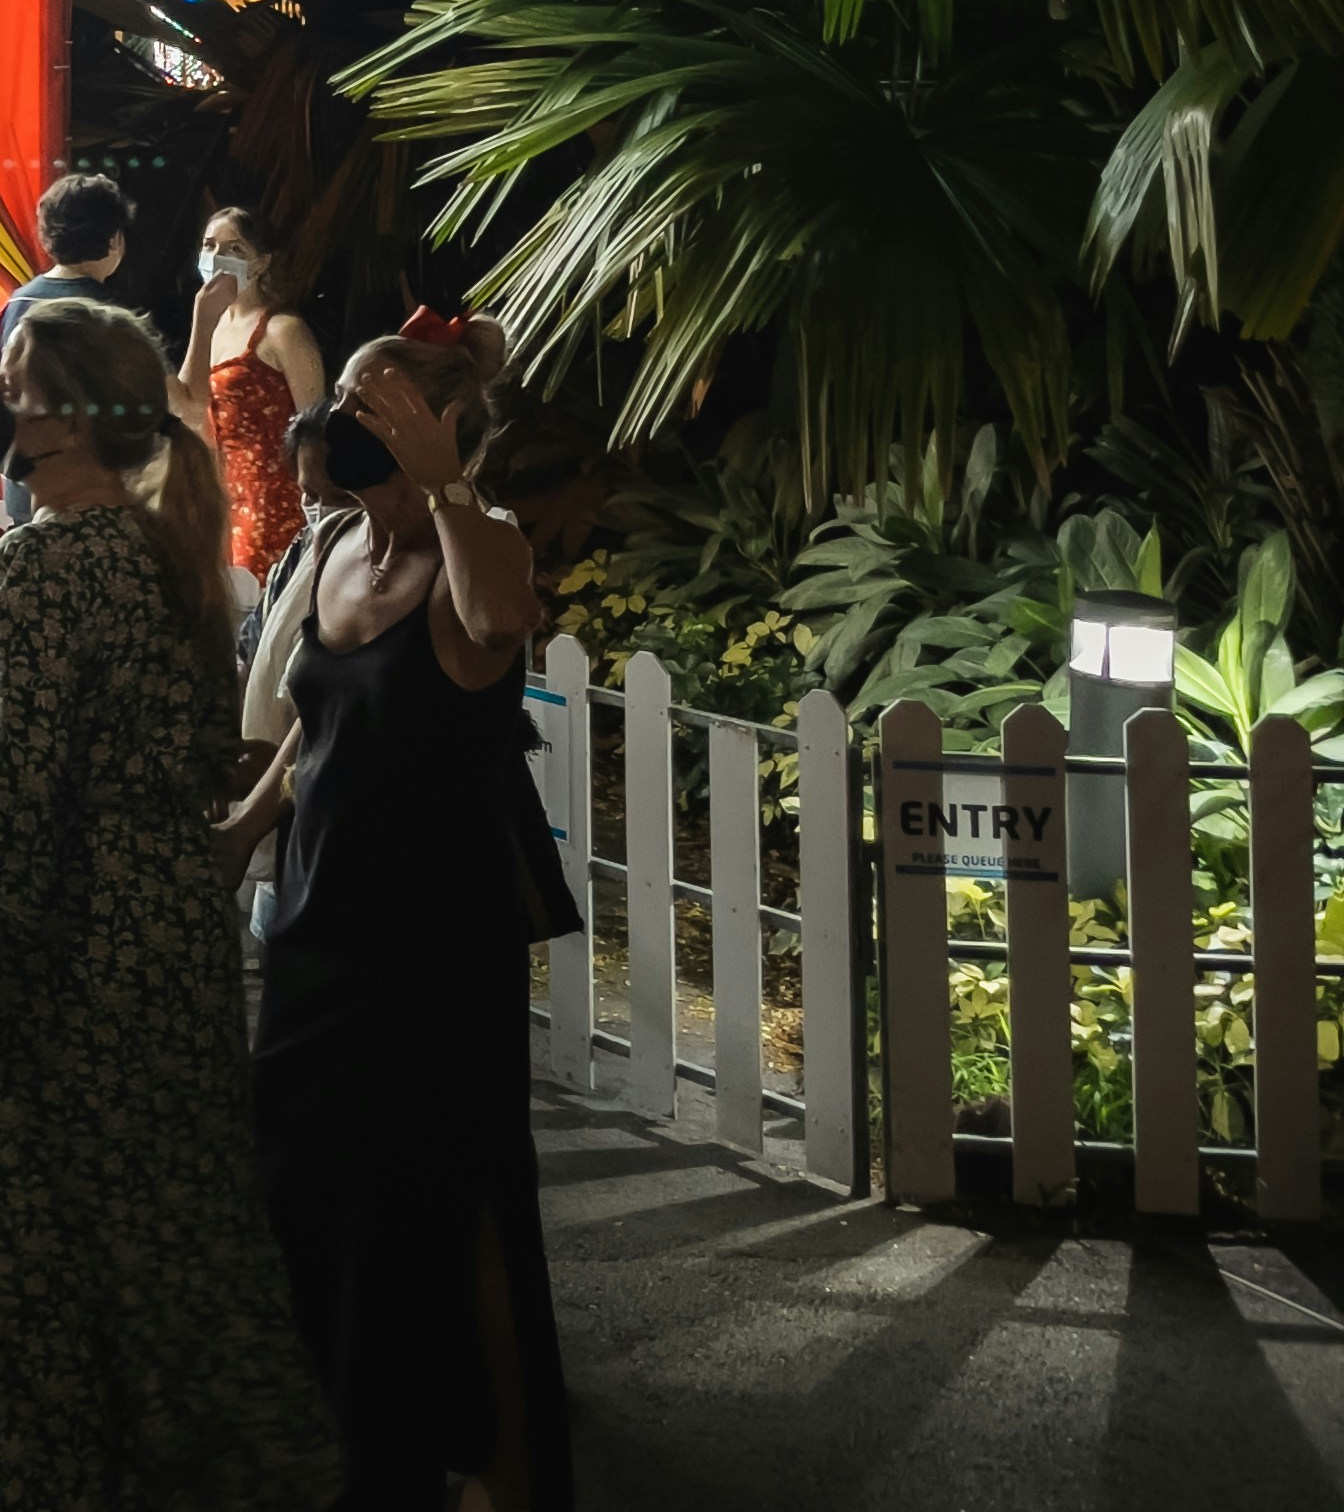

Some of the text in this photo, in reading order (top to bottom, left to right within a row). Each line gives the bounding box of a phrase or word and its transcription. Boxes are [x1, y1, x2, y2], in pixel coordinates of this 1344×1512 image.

[899, 800, 1052, 842] ENTRY
[912, 852, 1041, 869] PLEASE QUEUE HERE
